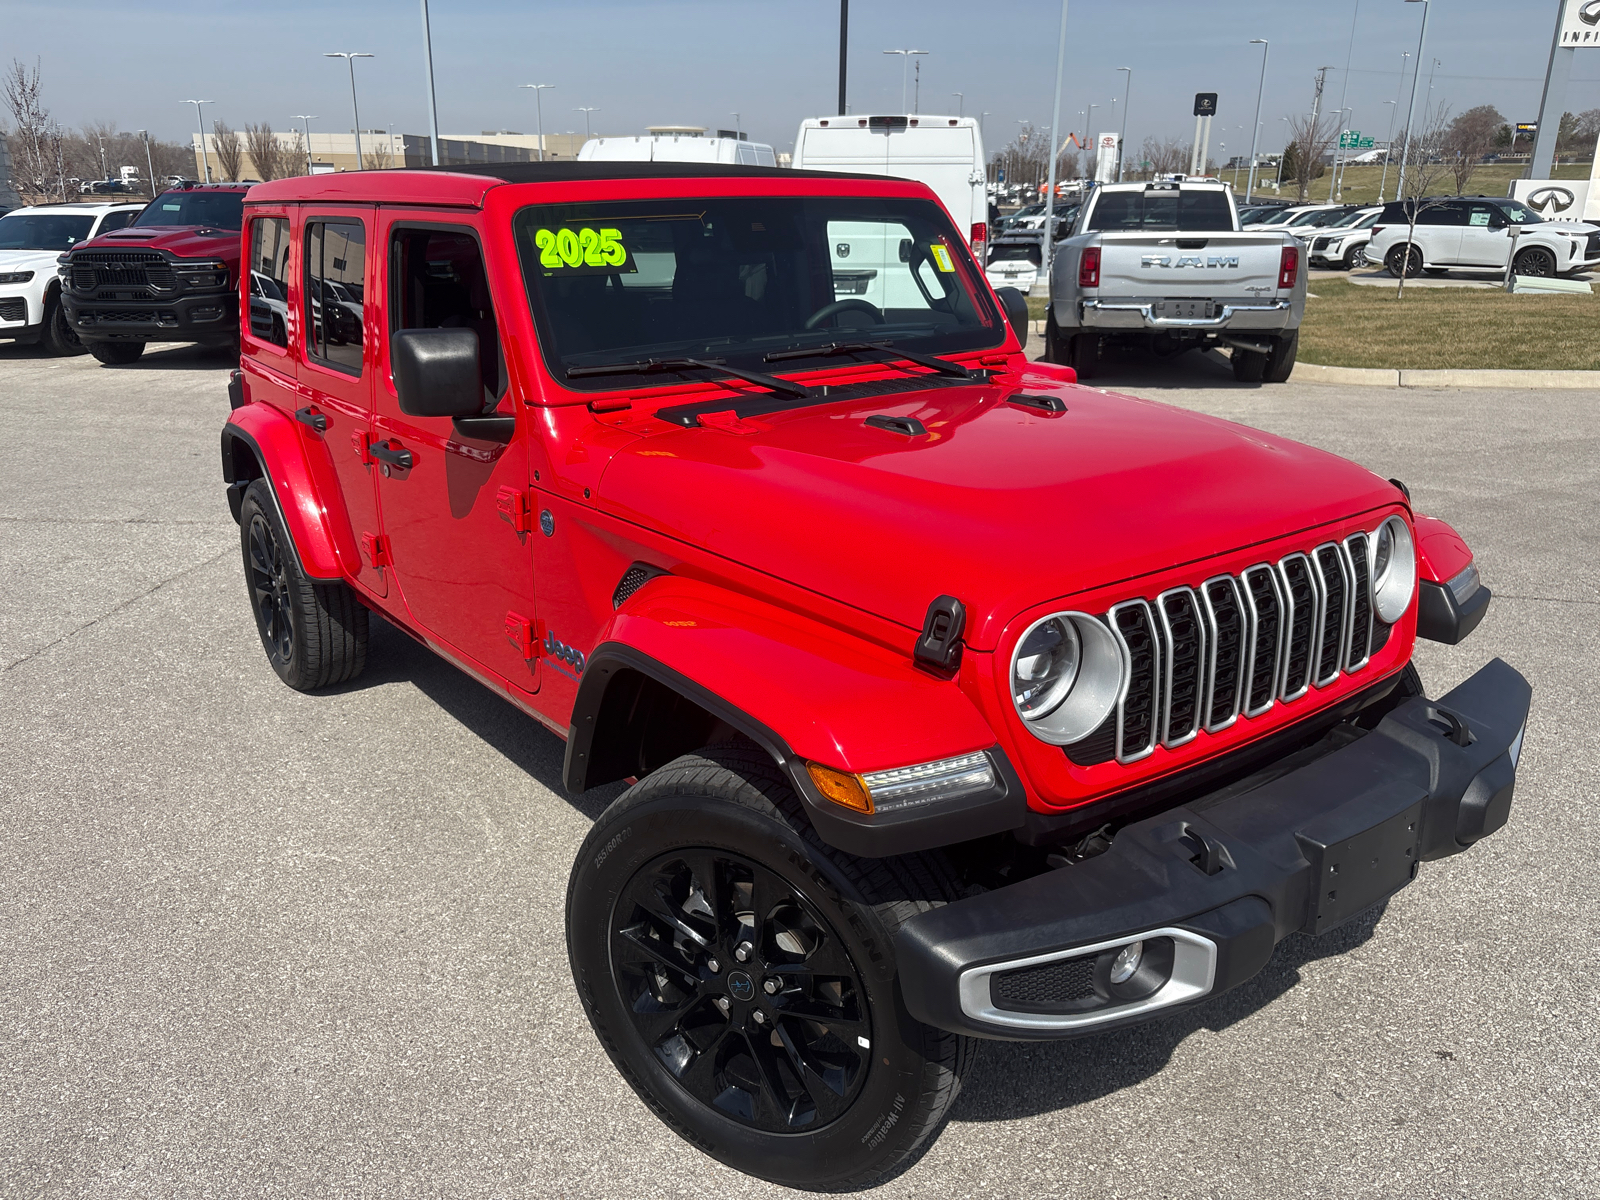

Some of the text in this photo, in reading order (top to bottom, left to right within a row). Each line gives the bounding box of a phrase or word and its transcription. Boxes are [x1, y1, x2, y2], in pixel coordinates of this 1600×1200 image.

[535, 227, 627, 268] 2025
[1141, 254, 1239, 268] RAM
[543, 629, 586, 675] Jeep
[595, 826, 633, 870] 255/60R20
[788, 850, 883, 963] NEXEN
[868, 1091, 906, 1152] All-Weather
